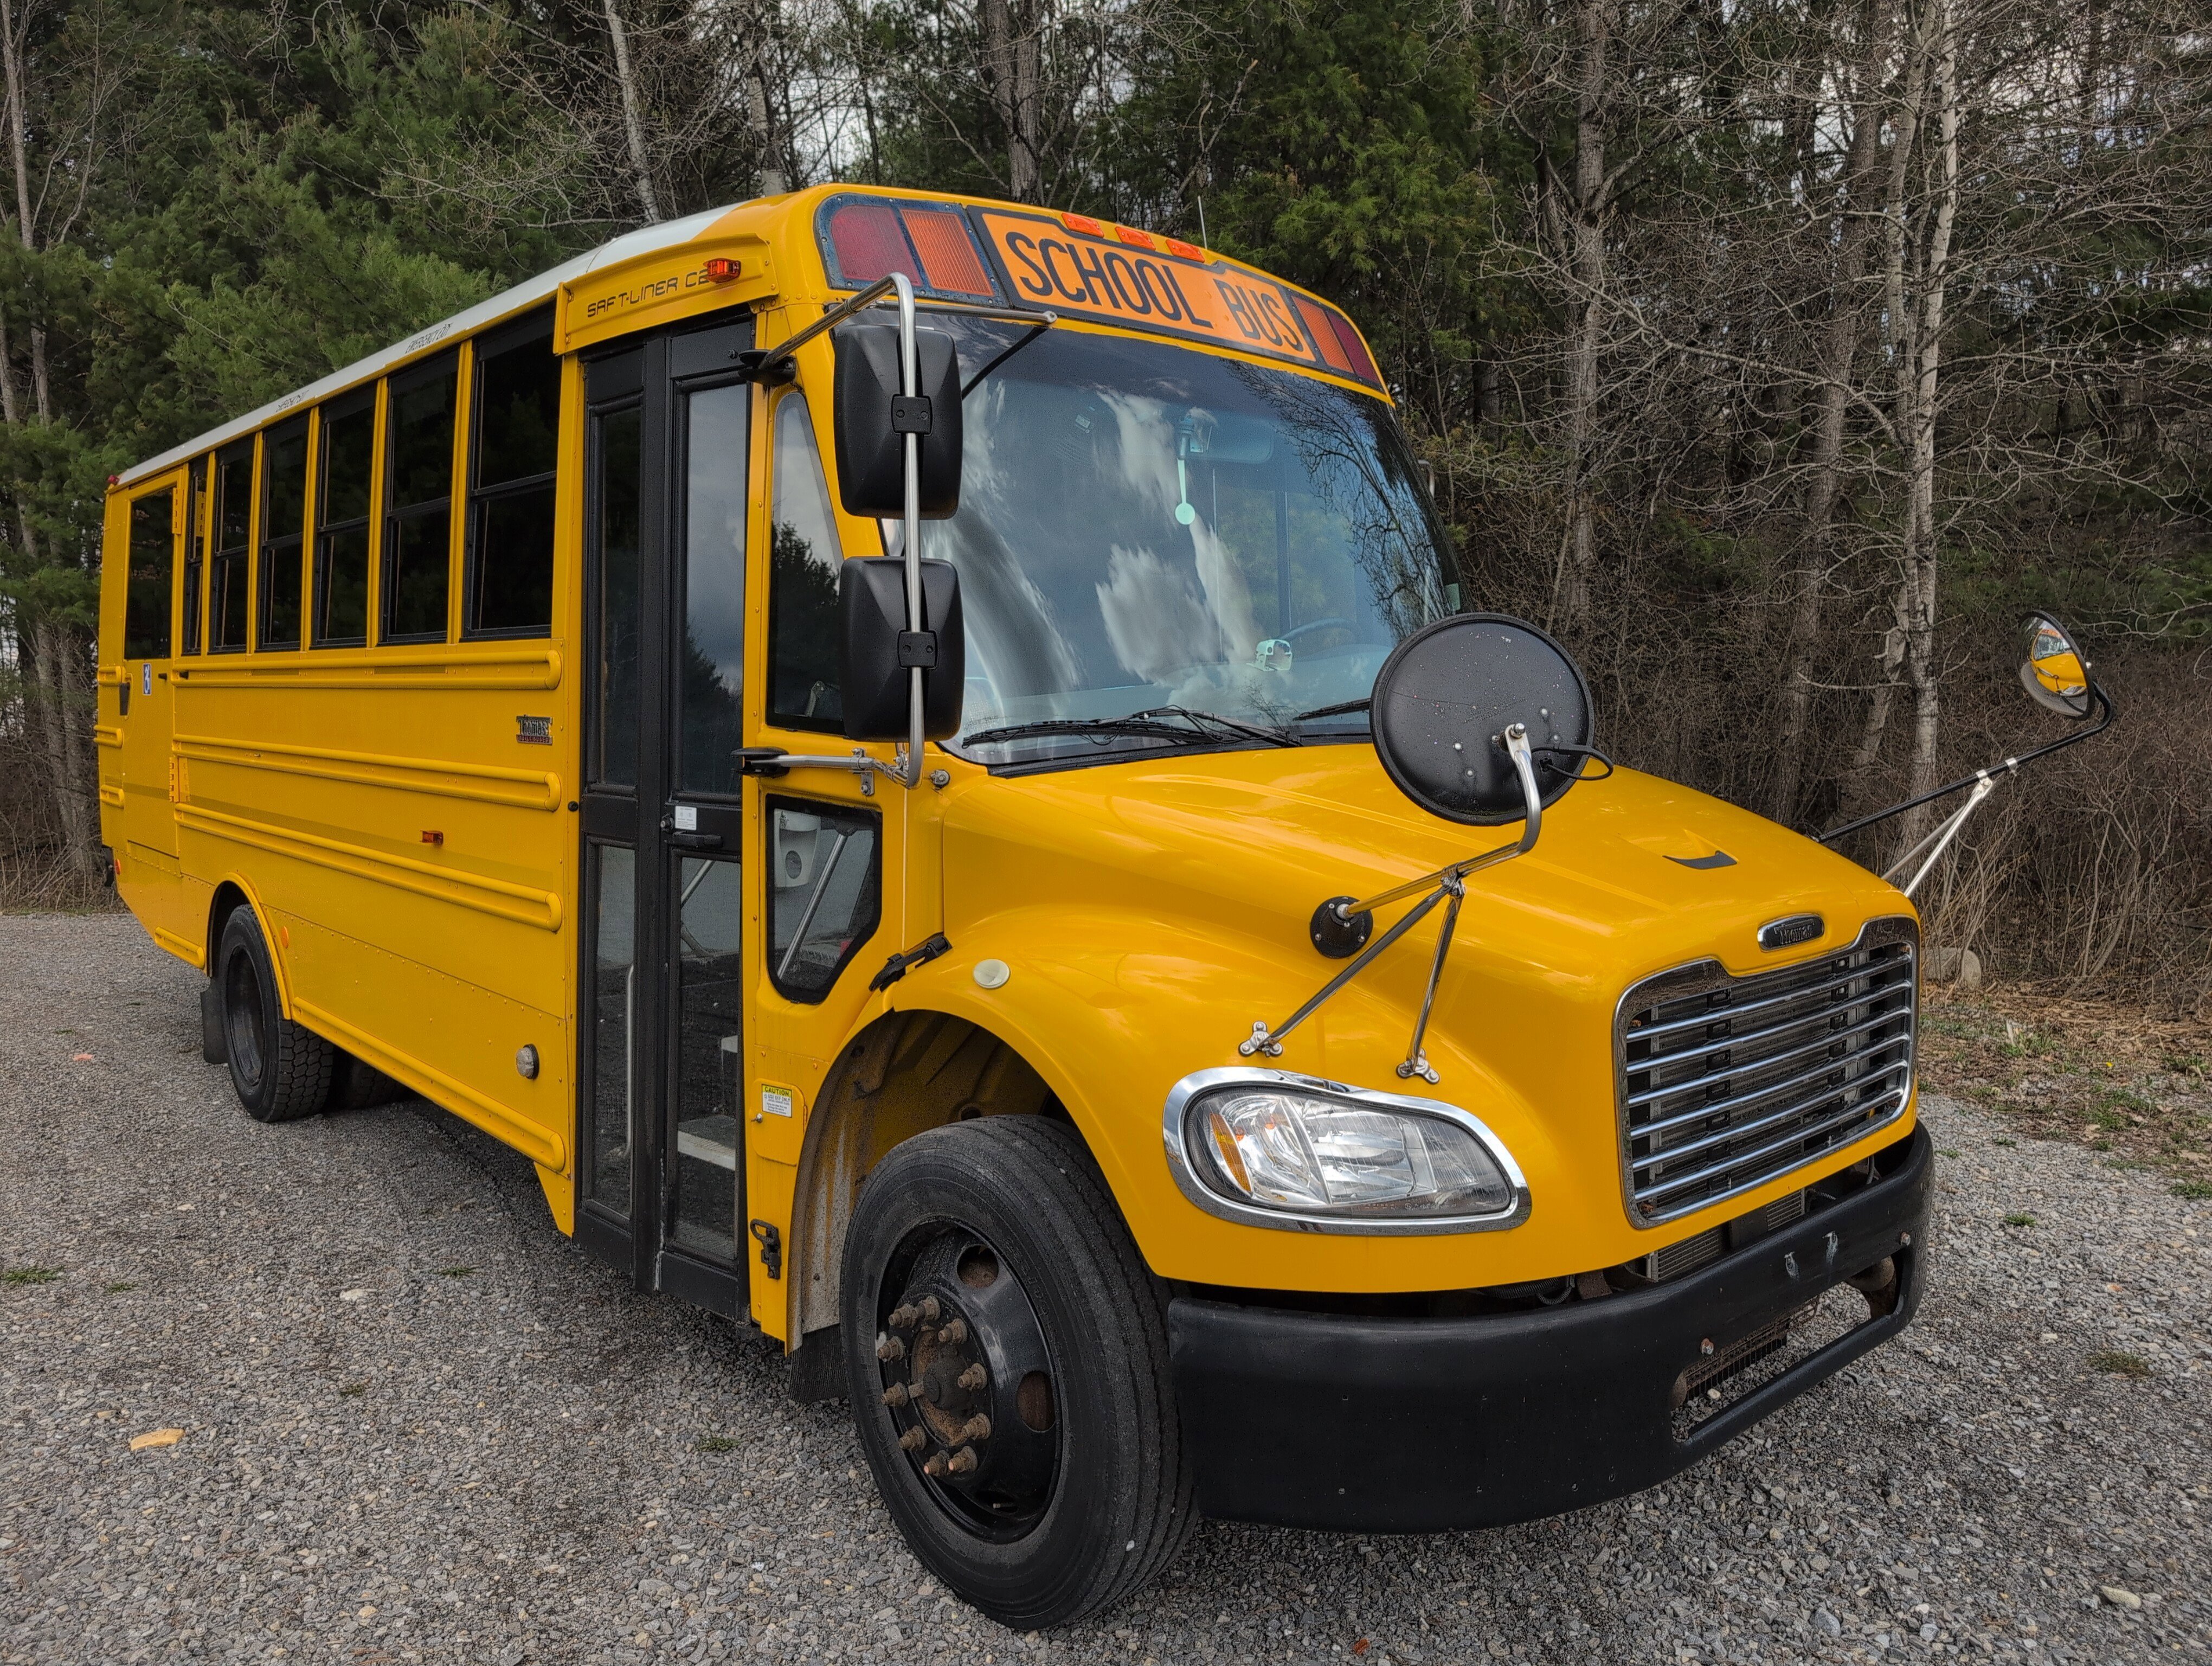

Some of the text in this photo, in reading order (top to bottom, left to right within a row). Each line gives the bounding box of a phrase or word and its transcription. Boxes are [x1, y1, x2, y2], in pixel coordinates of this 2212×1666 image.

[587, 277, 678, 318] SAFT-LINER
[1005, 231, 1304, 353] SCHOOL BUS
[516, 714, 553, 736] Thomas
[1773, 918, 1815, 945] Thomas
[764, 1086, 789, 1097] CAUTION
